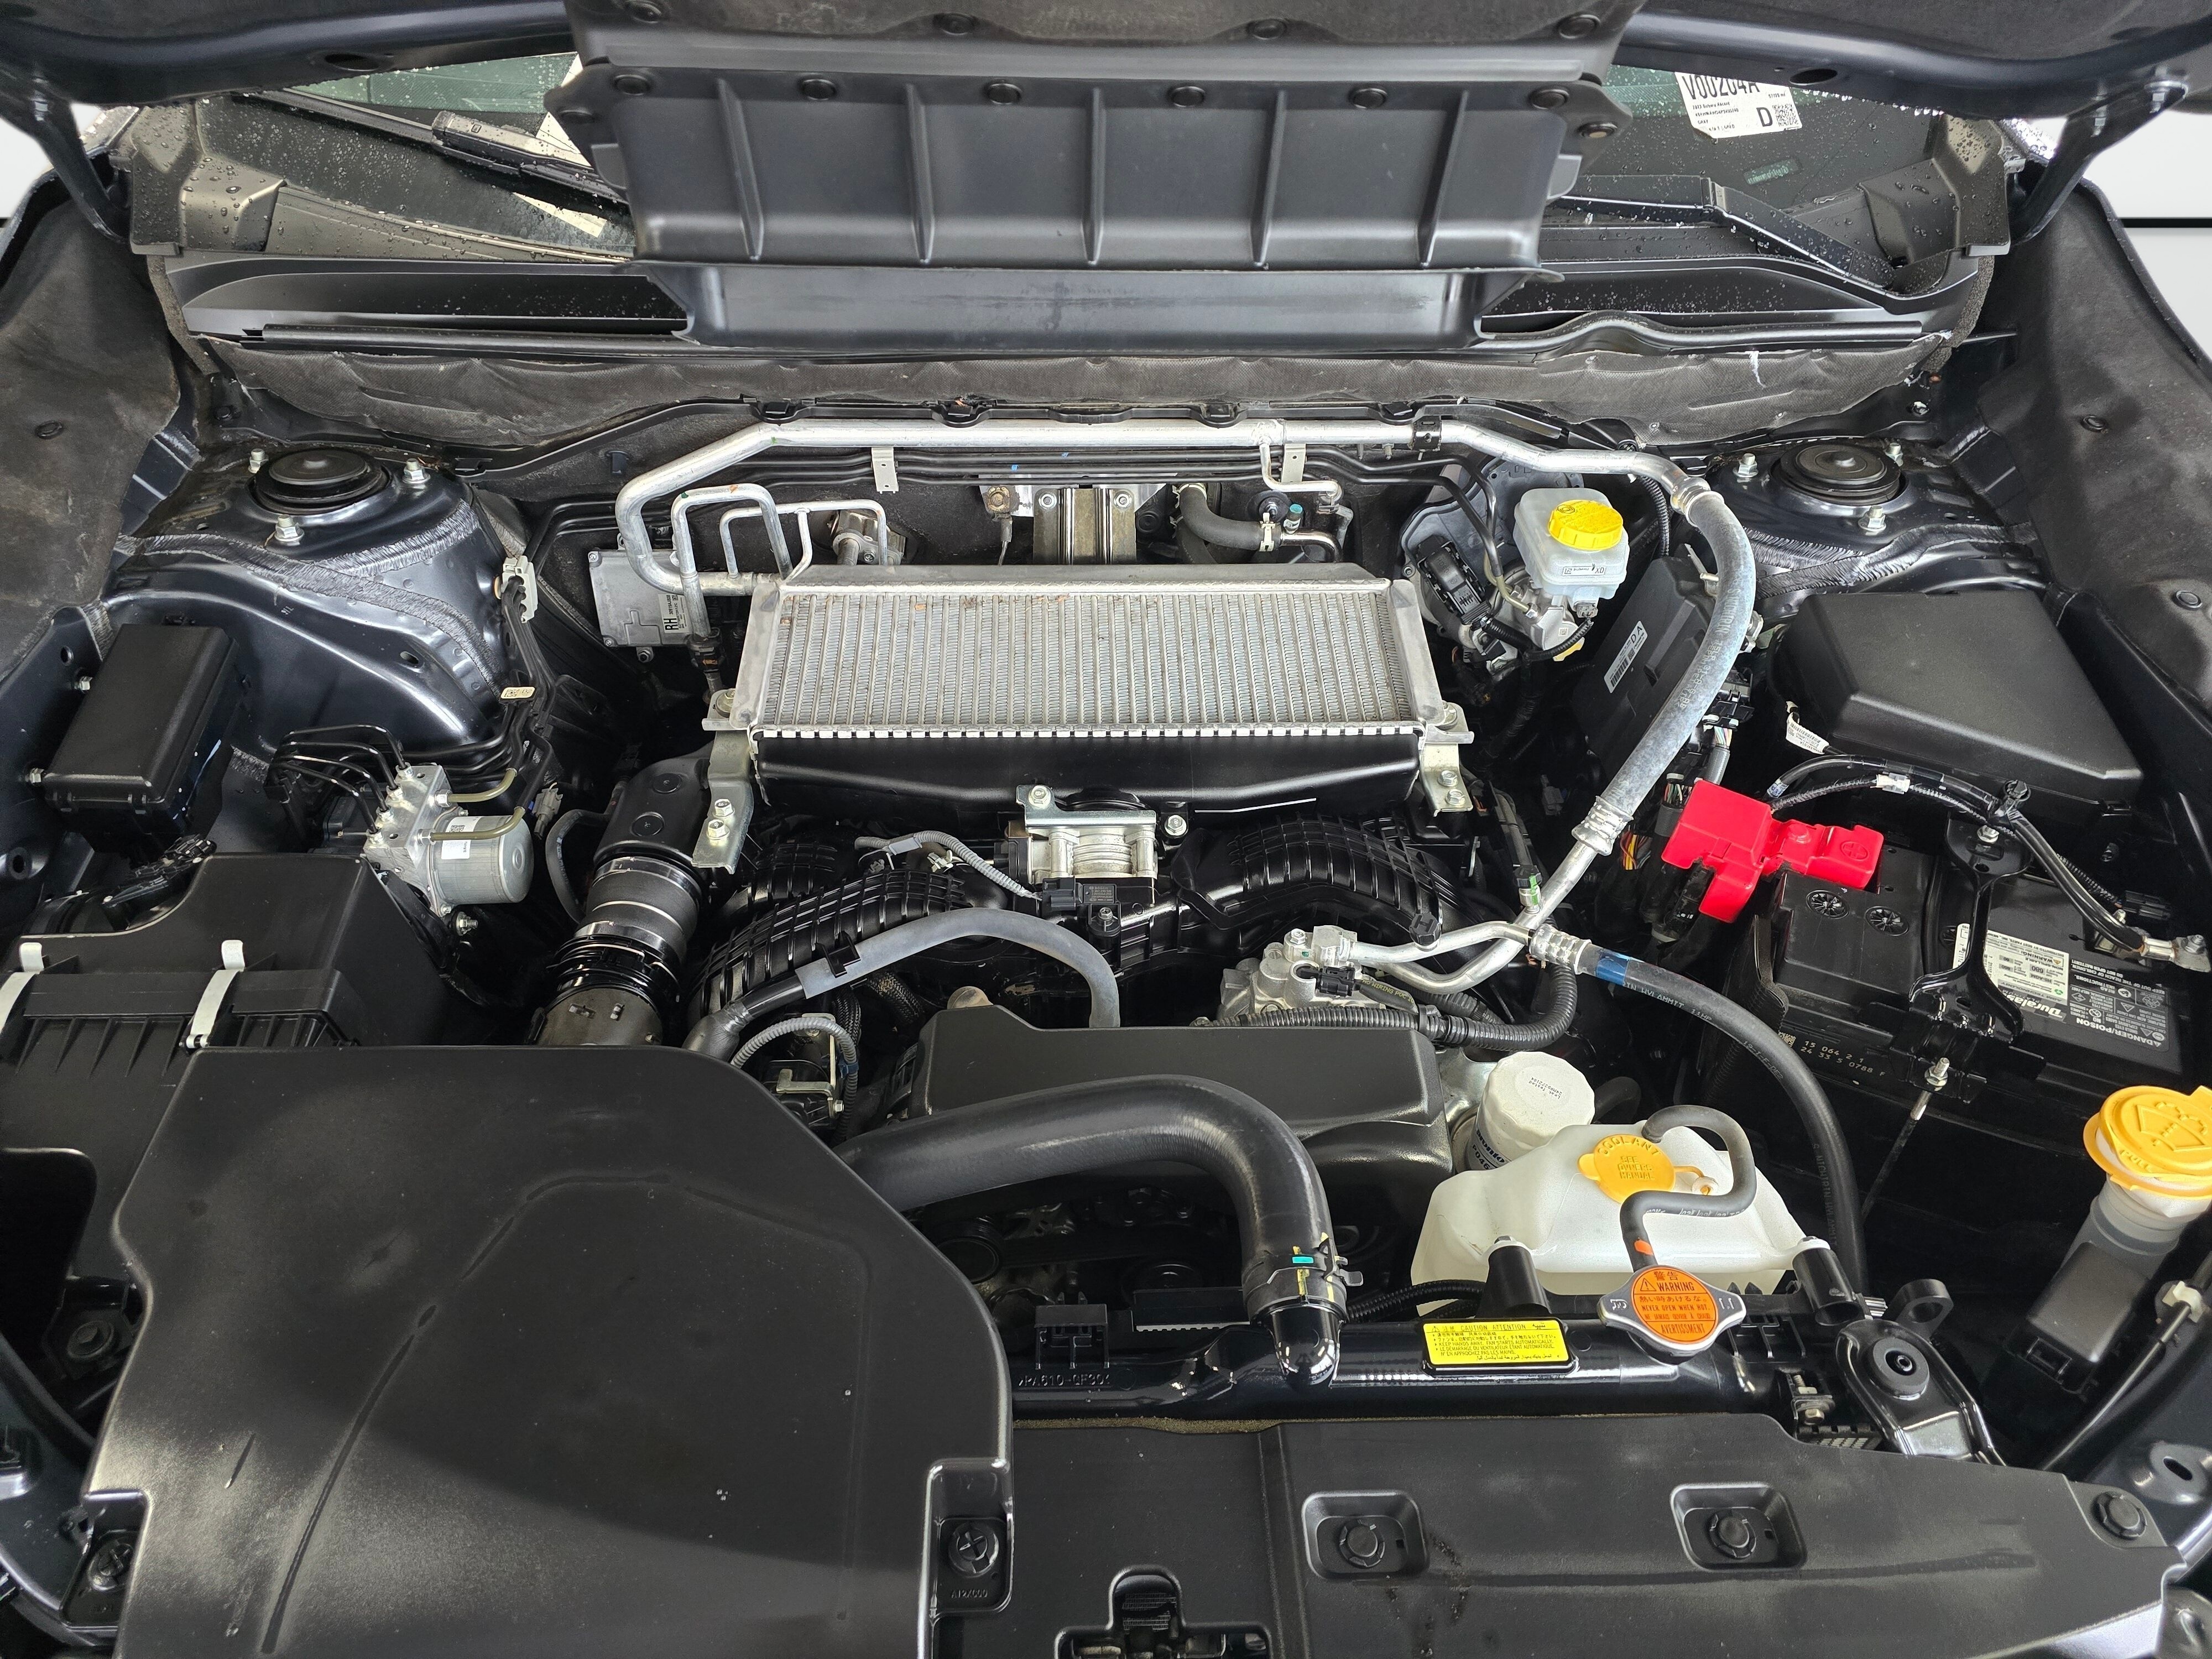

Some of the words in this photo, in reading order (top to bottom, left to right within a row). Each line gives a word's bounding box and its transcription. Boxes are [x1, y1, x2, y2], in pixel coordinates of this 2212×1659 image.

[1756, 107, 1773, 127] D
[663, 618, 679, 629] RH
[2020, 951, 2053, 963] WARNING:
[1371, 982, 1394, 994] WIRING
[1394, 990, 1406, 999] PVC
[2001, 982, 2044, 997] TECHNOLOGY
[2002, 989, 2039, 1003] PLATINUM
[2075, 1018, 2153, 1045] DANGER/POISON
[1821, 1046, 1840, 1056] 064
[1800, 1046, 1812, 1054] 24
[1818, 1052, 1830, 1060] 33
[1848, 1061, 1873, 1073] 0788
[1548, 1091, 1560, 1099] Leak
[1598, 1136, 1660, 1155] COOLANT
[1654, 1271, 1678, 1281] 警告
[1656, 1282, 1694, 1292] WARNING
[1661, 1324, 1705, 1334] AVERTISSMENT
